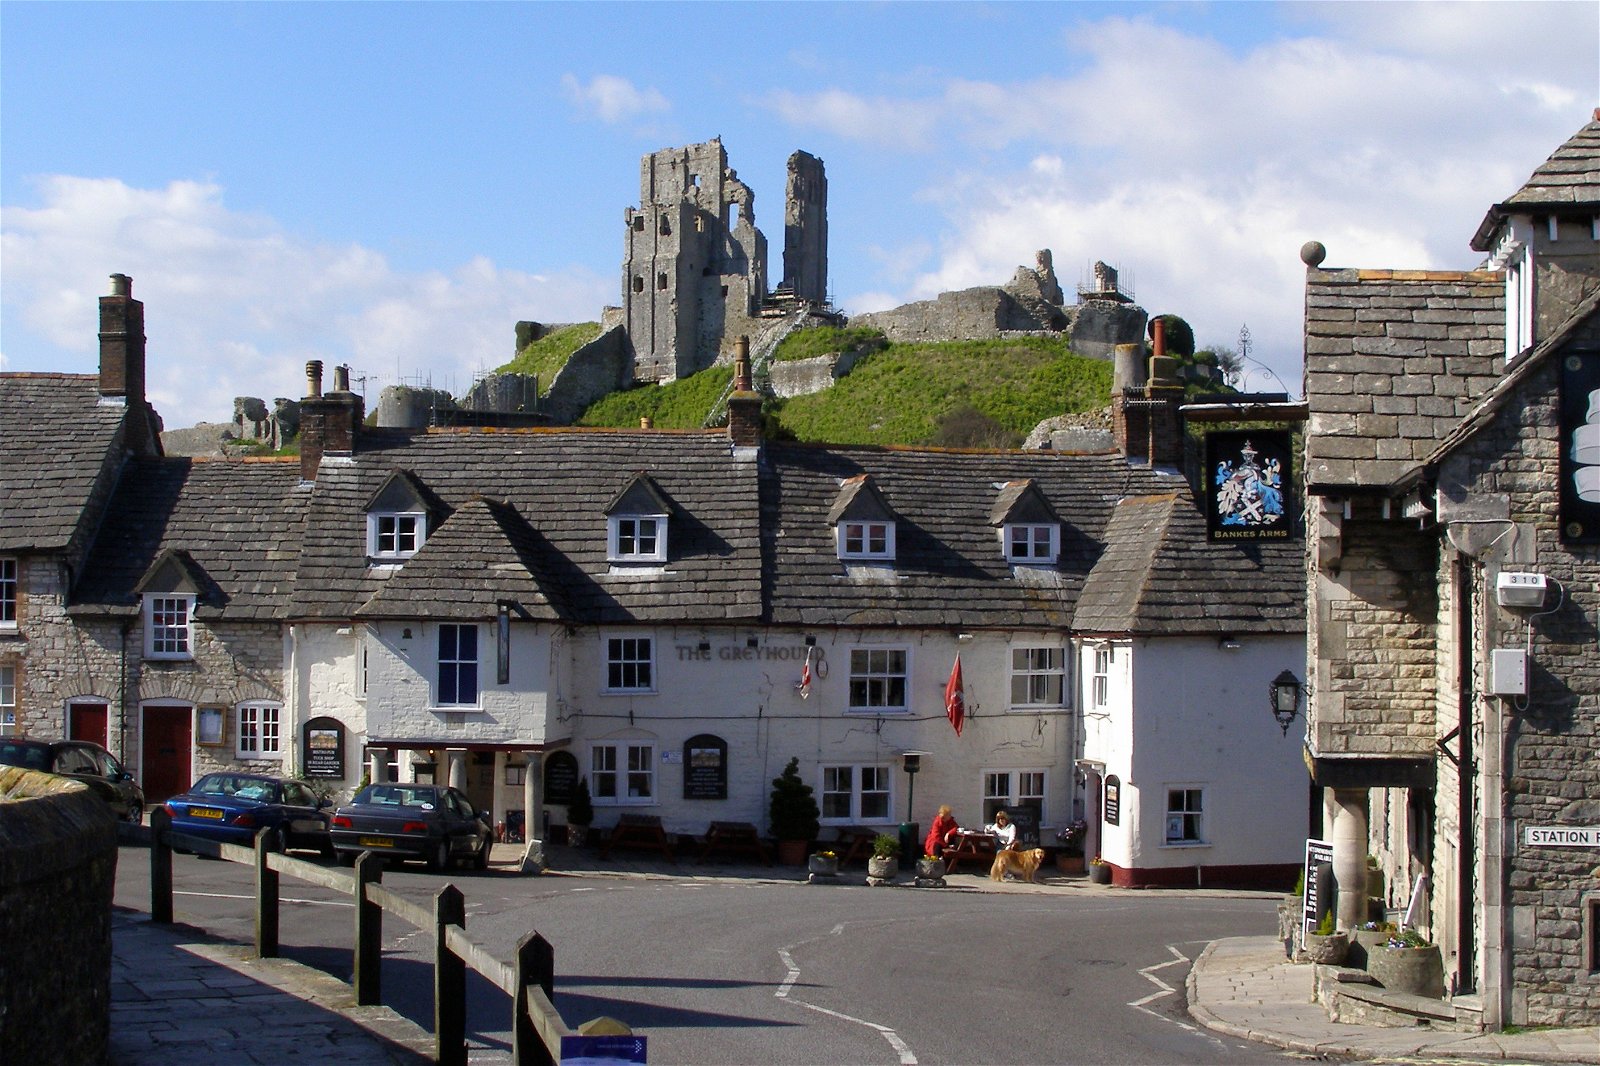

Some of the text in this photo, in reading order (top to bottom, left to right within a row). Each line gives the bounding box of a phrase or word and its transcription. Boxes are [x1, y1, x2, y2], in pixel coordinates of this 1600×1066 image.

[1214, 529, 1288, 538] BANKES ARMS
[675, 646, 712, 661] THE
[1532, 830, 1589, 843] STATION
